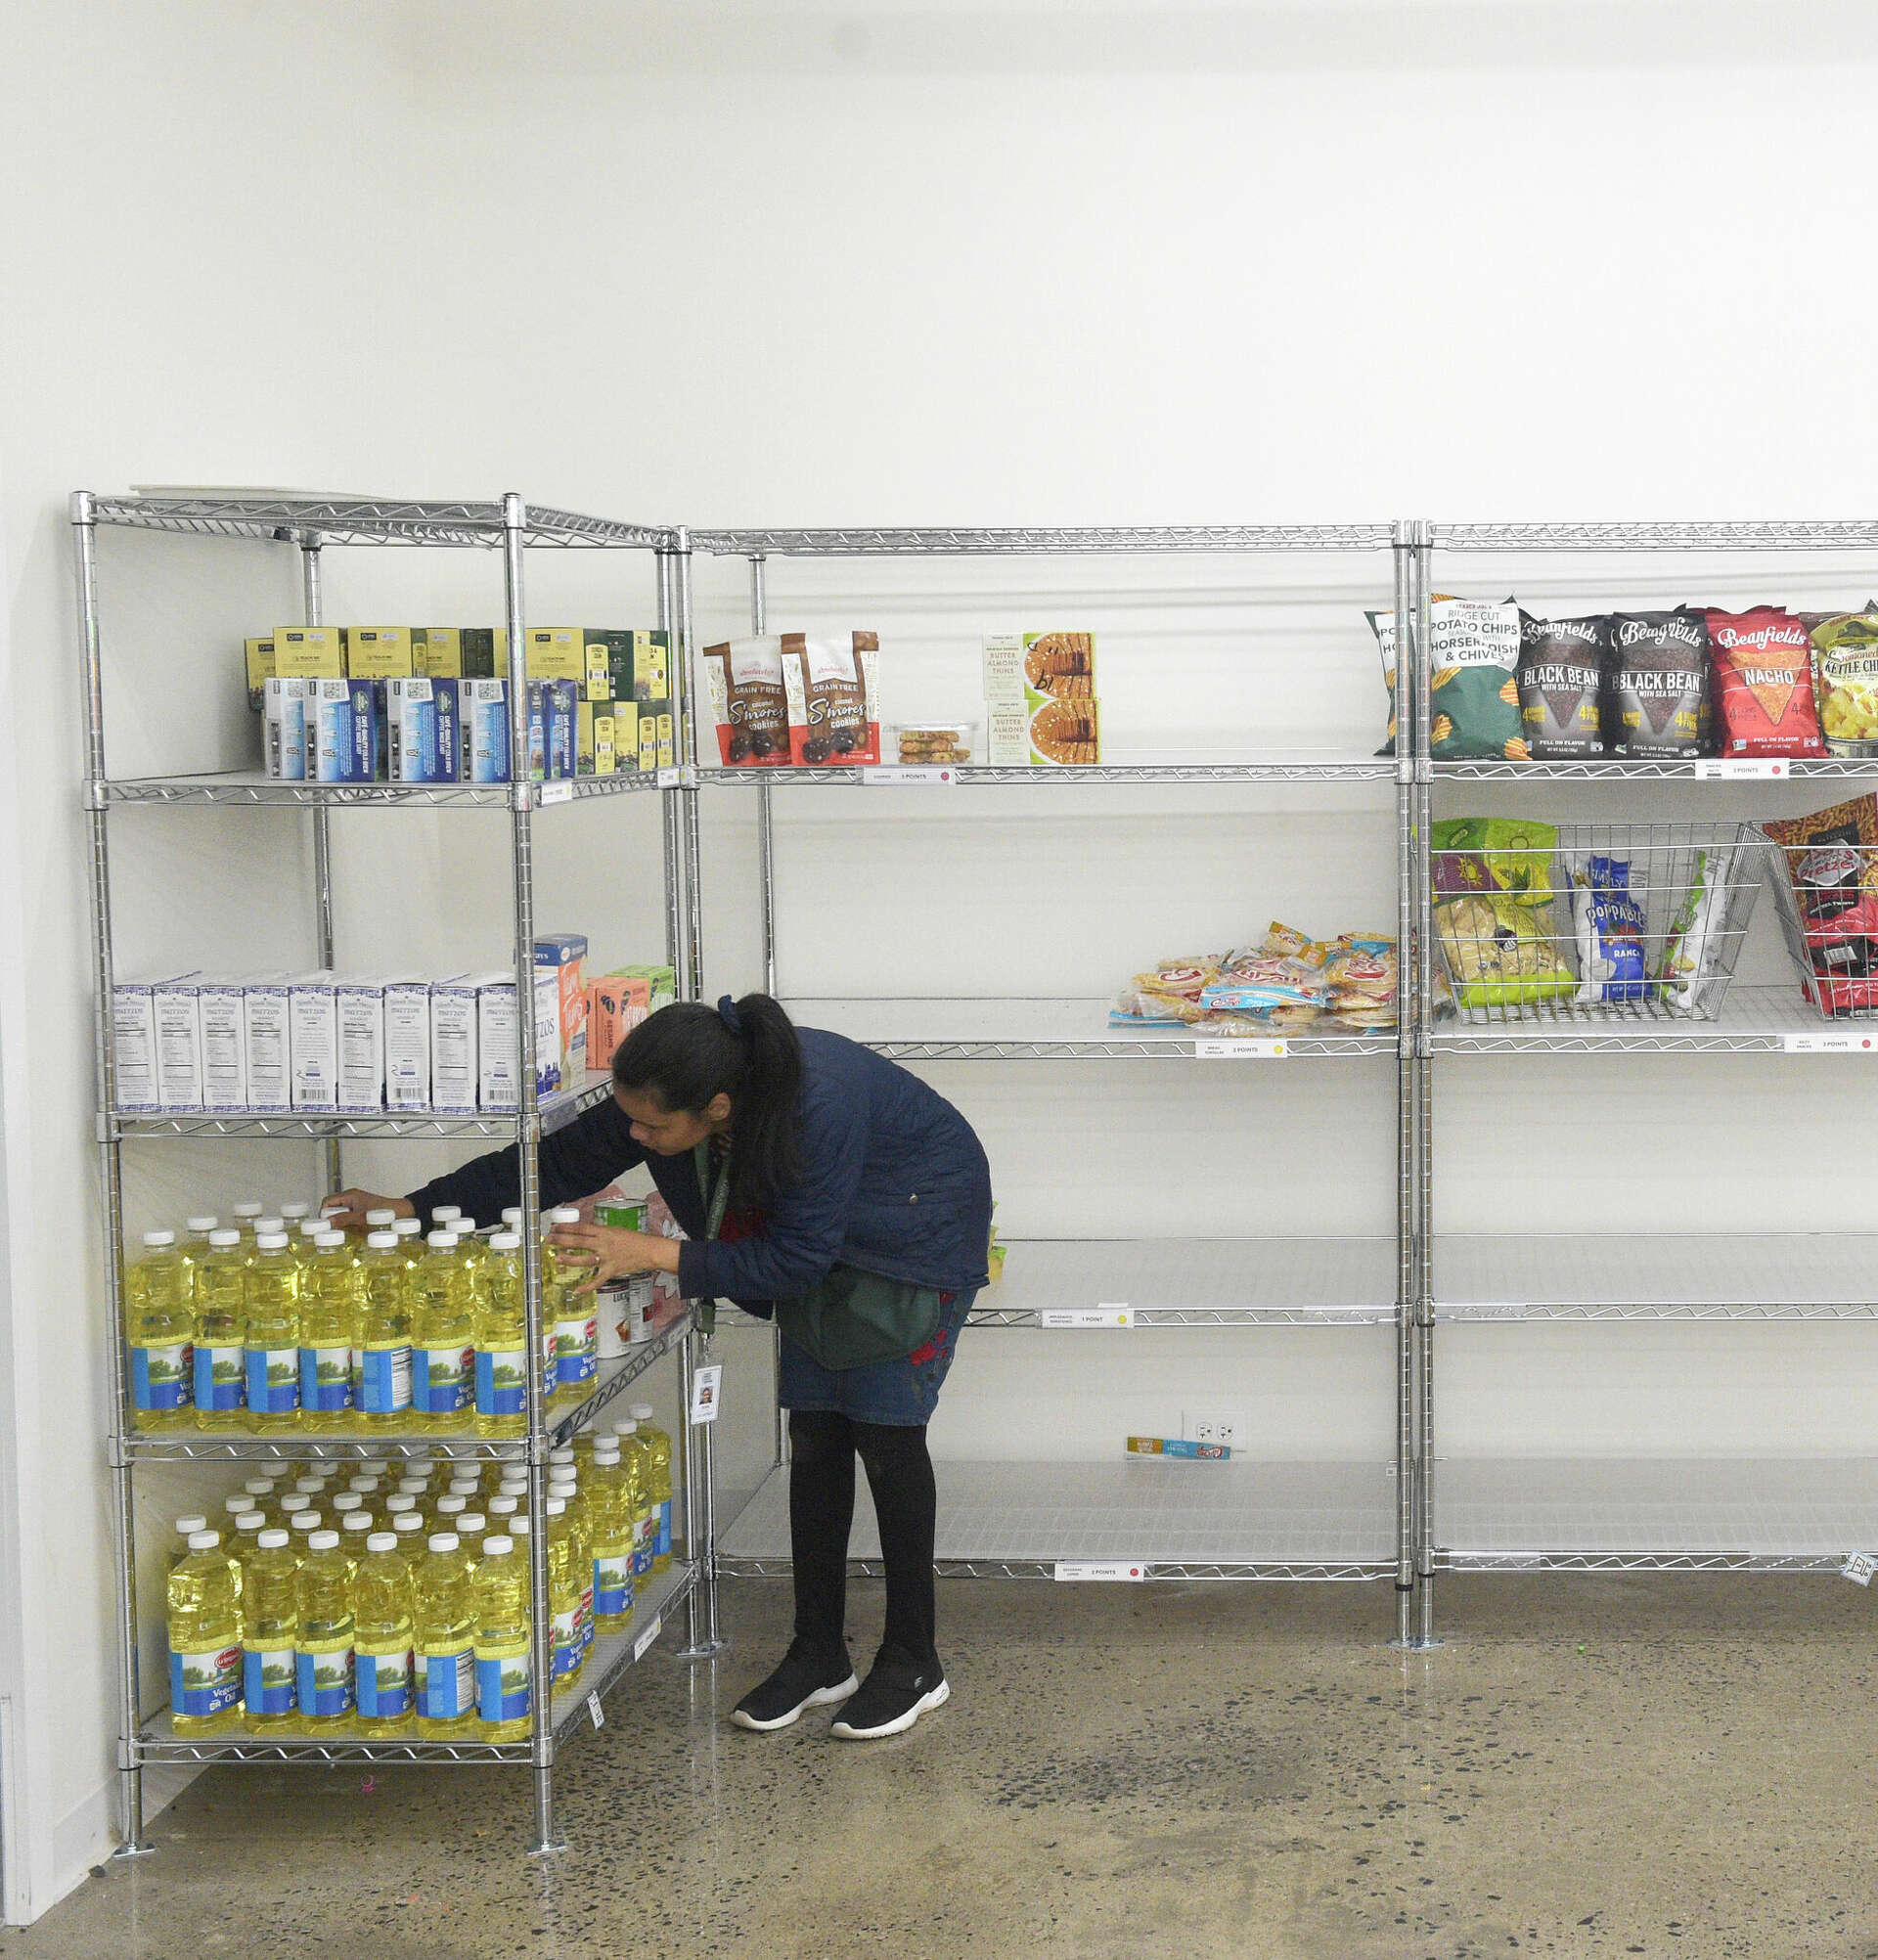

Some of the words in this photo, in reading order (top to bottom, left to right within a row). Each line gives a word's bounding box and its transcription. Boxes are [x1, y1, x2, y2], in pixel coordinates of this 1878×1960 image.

[1449, 609, 1477, 620] RIDGE
[1480, 611, 1500, 620] CUT
[1431, 619, 1478, 633] POTATO
[1481, 623, 1517, 635] CHIPS
[1718, 626, 1807, 649] Beanfields
[1446, 651, 1454, 661] &
[1825, 660, 1860, 675] KETTLE
[1524, 667, 1564, 686] BLACK
[1568, 668, 1599, 686] BEAN
[1619, 673, 1662, 690] BLACK
[1667, 674, 1700, 691] BEAN
[1744, 670, 1794, 685] NACHO
[730, 700, 786, 725] S'mores
[809, 697, 866, 725] S'mores
[749, 720, 779, 730] cookies
[830, 717, 860, 729] cookies
[1587, 903, 1645, 927] POPPABLE
[1614, 949, 1640, 958] RANC
[535, 1018, 555, 1039] TZOS
[213, 1682, 241, 1697] Vegeta
